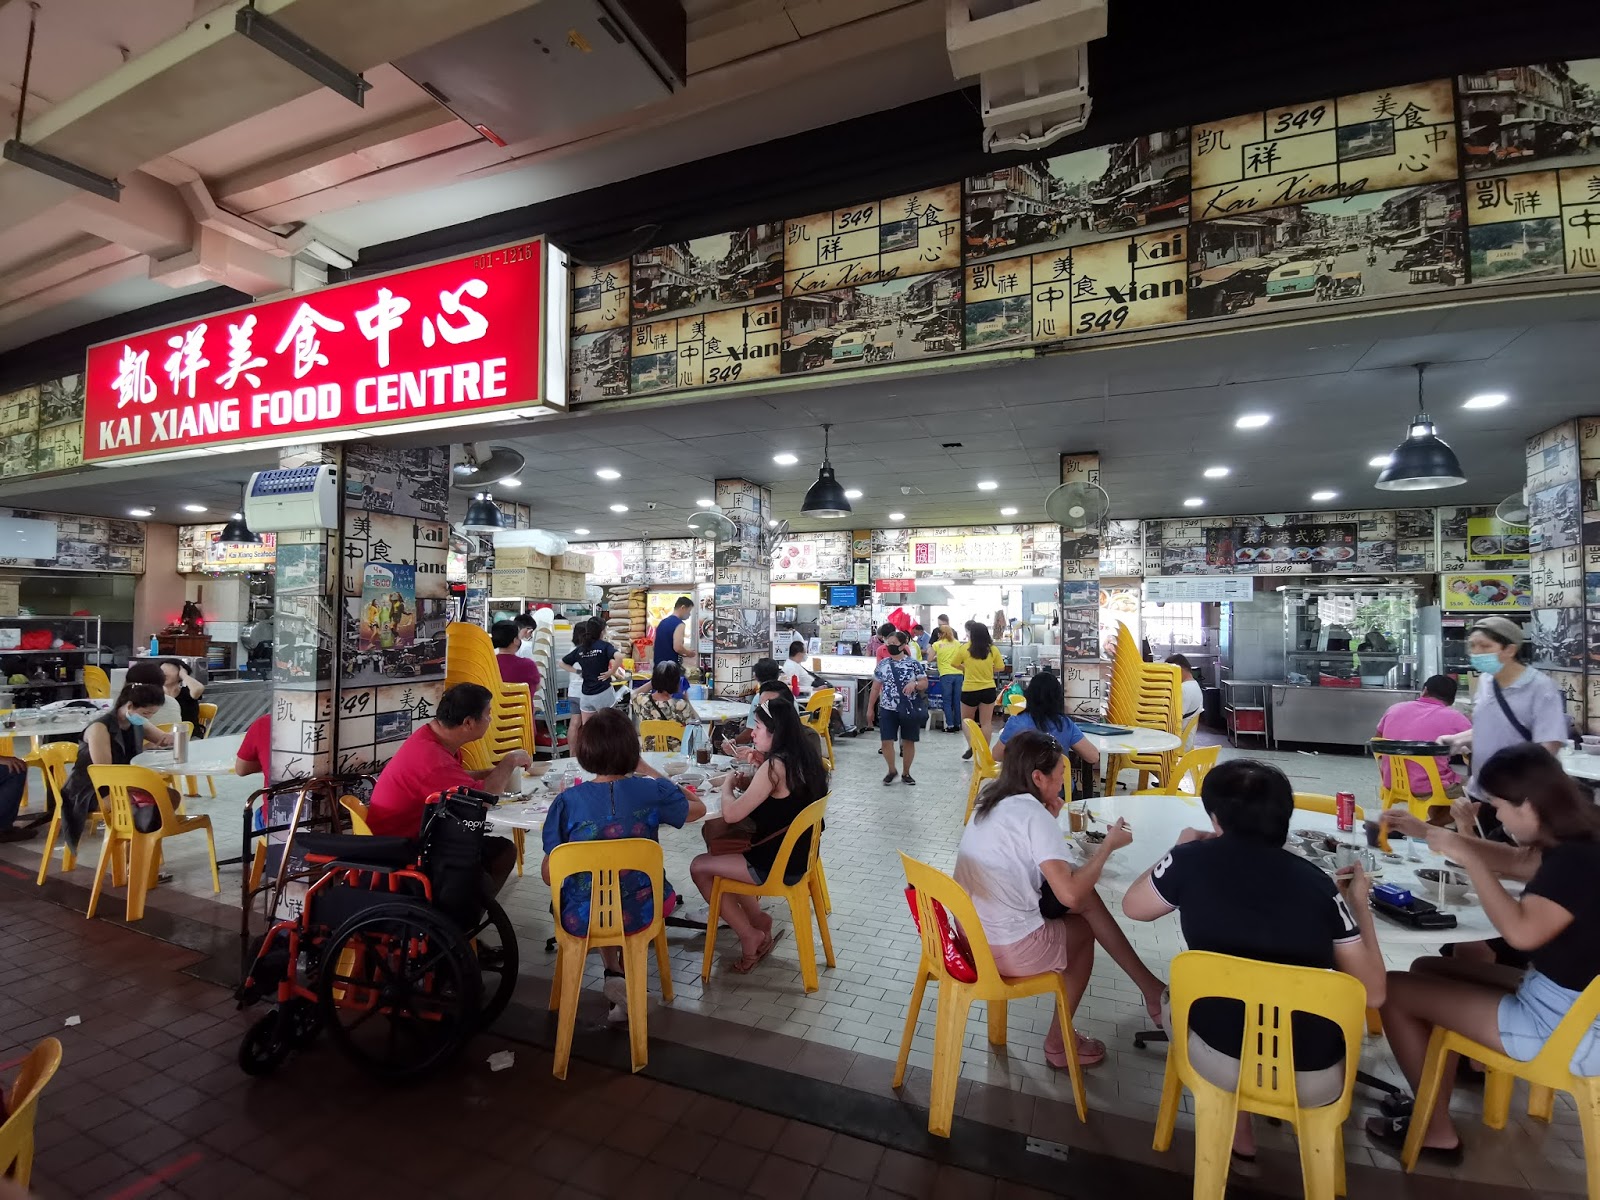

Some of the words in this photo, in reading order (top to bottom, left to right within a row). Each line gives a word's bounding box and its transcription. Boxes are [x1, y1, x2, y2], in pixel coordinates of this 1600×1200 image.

[1273, 105, 1326, 134] 349
[1196, 129, 1231, 157] 凯
[1246, 142, 1282, 174] 祥
[1201, 186, 1261, 218] Kai
[1272, 173, 1369, 204] Xiang
[838, 206, 874, 230] 349
[788, 223, 811, 246] 凯
[820, 236, 843, 261] 祥
[1127, 233, 1183, 264] Kai
[790, 269, 831, 296] Kai
[836, 261, 901, 287] Xiang
[741, 306, 778, 329] Kai
[1075, 305, 1130, 335] 349
[706, 362, 743, 384] 349
[99, 413, 142, 451] KAI
[150, 397, 240, 443] XIANG
[251, 381, 343, 429] FOOD
[355, 356, 508, 415] CENTRE
[412, 524, 443, 543] Kai
[253, 550, 276, 558] Seafood
[1066, 560, 1096, 579] 凱祥
[1274, 565, 1293, 573] 349
[1445, 562, 1465, 571] 349
[1489, 599, 1511, 607] Ayam
[1547, 591, 1565, 607] 349
[277, 698, 296, 722] 凯
[303, 724, 328, 752] 祥
